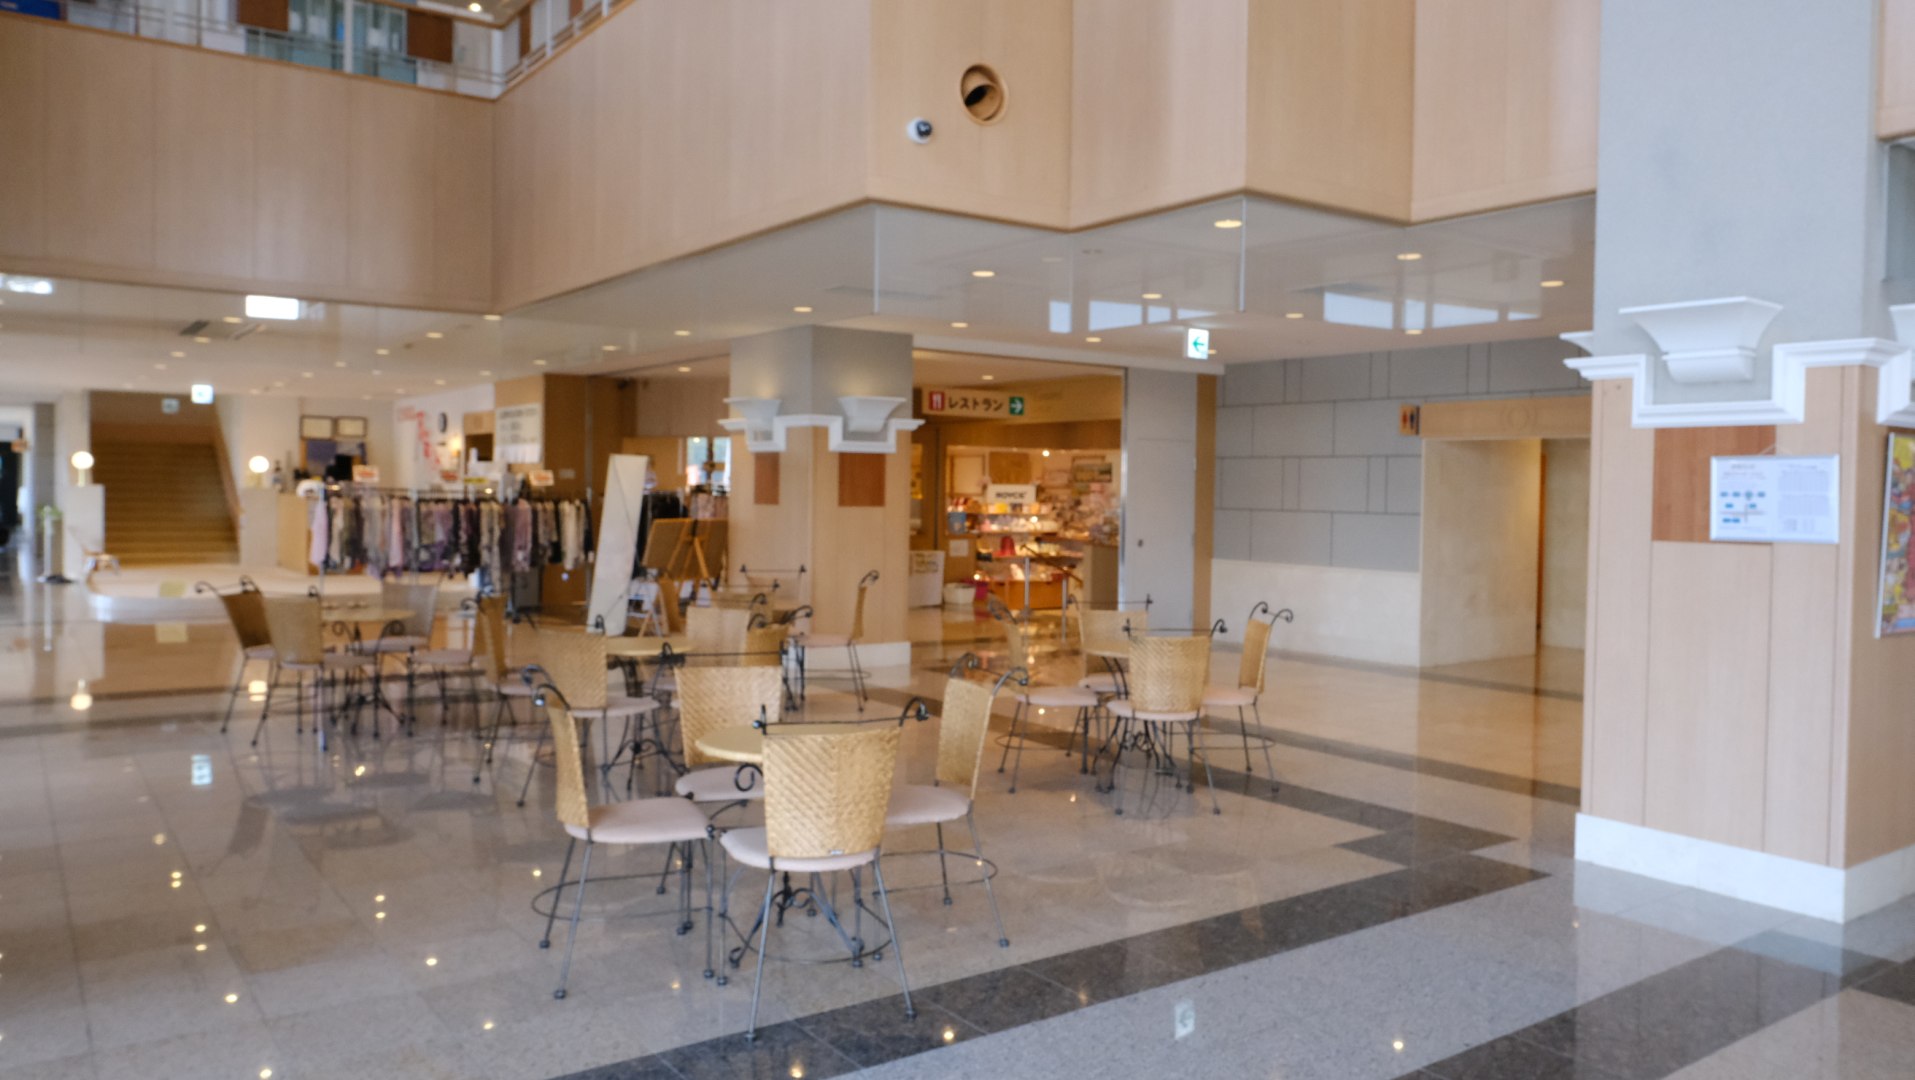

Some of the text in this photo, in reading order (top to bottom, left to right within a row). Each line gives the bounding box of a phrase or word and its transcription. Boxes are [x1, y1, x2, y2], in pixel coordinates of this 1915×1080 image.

[948, 397, 1004, 412] レストラン
